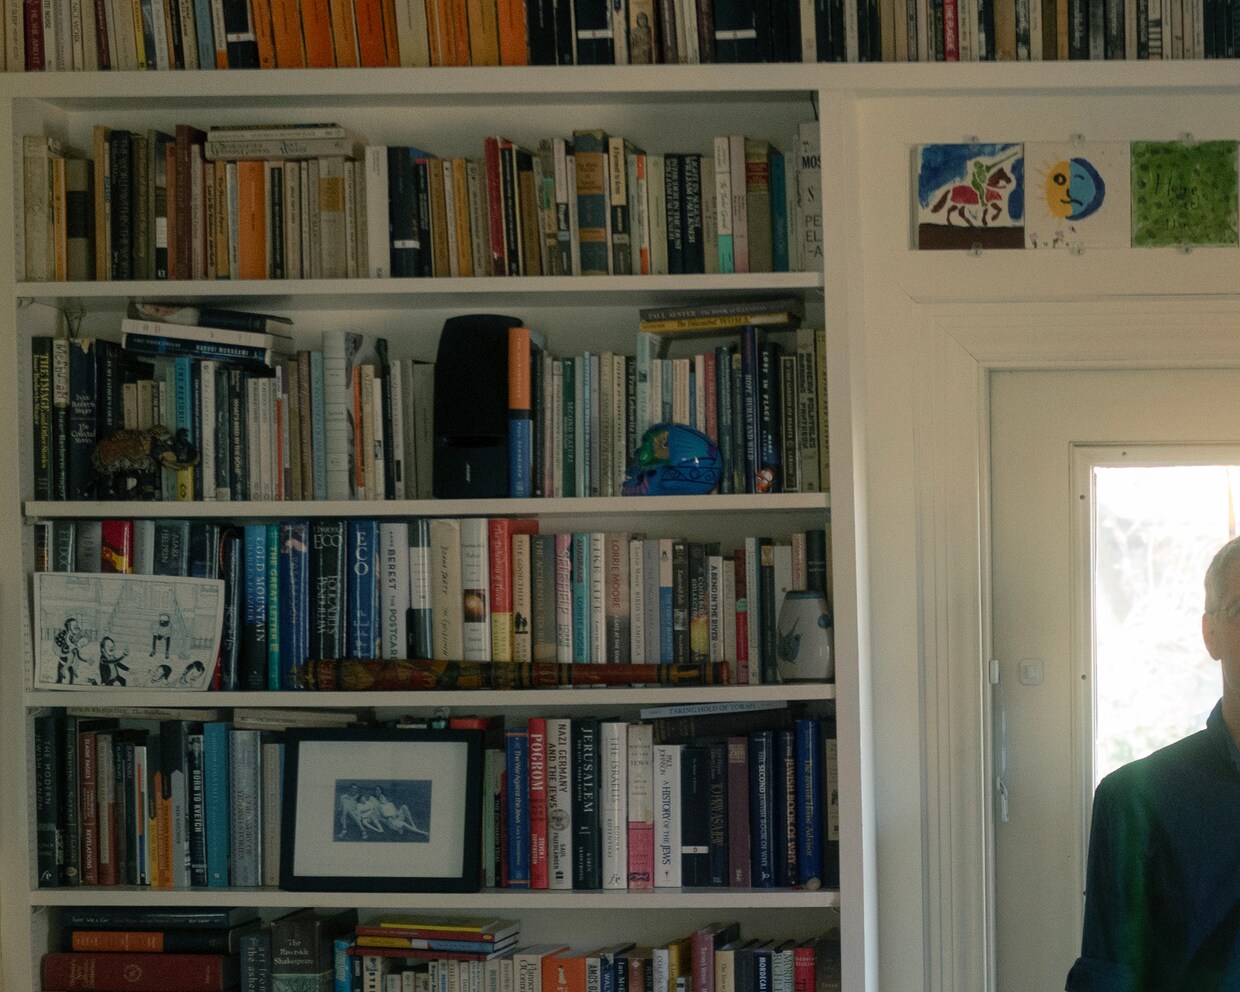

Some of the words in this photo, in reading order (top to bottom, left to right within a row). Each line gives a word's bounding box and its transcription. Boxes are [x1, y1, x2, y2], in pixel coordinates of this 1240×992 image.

[763, 380, 769, 389] IN
[255, 537, 265, 572] COLD
[612, 540, 621, 572] LORRIE
[388, 549, 397, 590] BEREST
[612, 574, 621, 608] MOORE
[711, 592, 717, 601] IN
[256, 576, 265, 642] MOUNTAIN
[558, 724, 567, 746] NAZI
[530, 734, 544, 791] POGROM
[548, 743, 556, 762] AND
[193, 770, 201, 791] BORN
[548, 765, 556, 782] THE
[558, 749, 567, 793] GERMANY
[582, 728, 593, 813] JERUSALEM
[193, 794, 202, 802] TO
[549, 785, 557, 808] JEWS
[662, 786, 671, 820] HISTORY
[194, 805, 202, 832] KVETCH
[664, 821, 669, 829] OF
[661, 844, 671, 865] JEWS
[248, 947, 257, 963] the
[259, 947, 267, 963] art
[588, 965, 597, 984] AMOS
